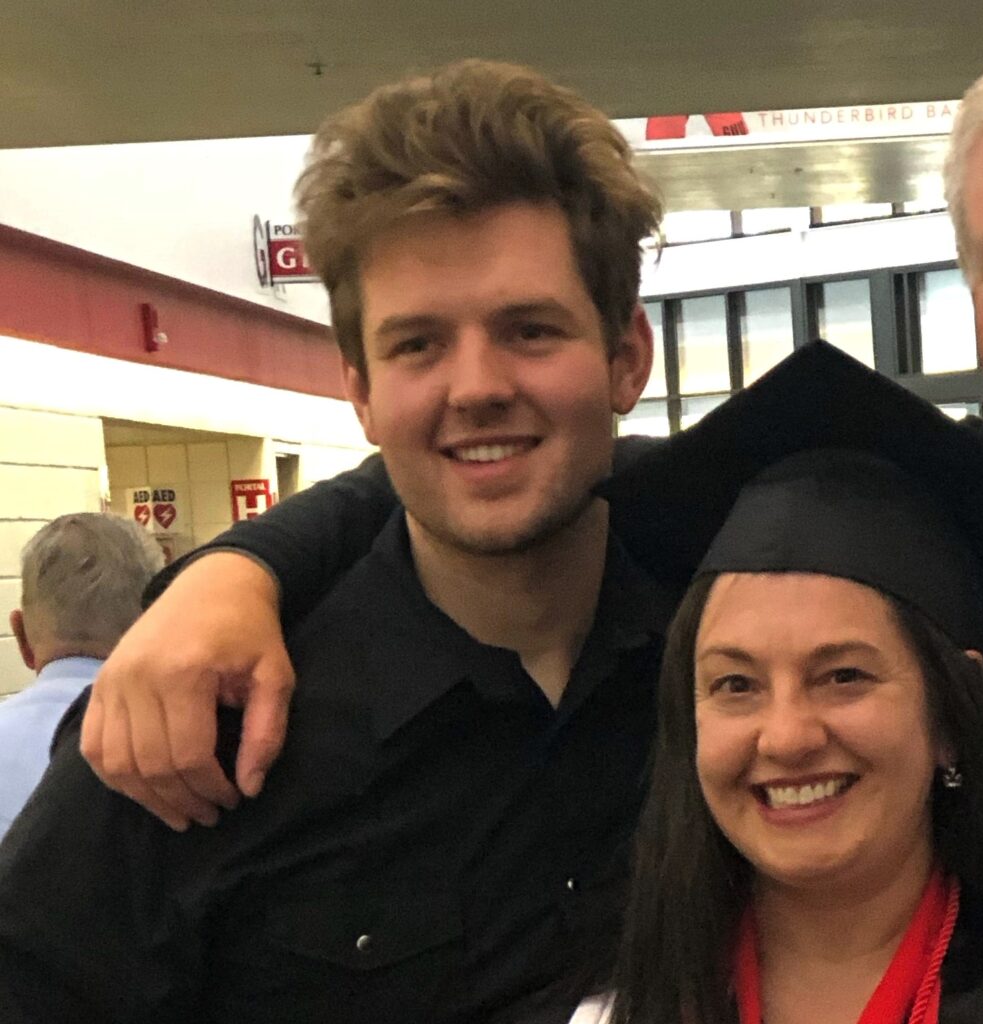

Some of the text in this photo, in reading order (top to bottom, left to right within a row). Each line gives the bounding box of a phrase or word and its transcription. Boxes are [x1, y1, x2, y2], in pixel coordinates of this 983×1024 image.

[758, 105, 913, 129] THUNDERBIRD
[133, 490, 150, 503] AED
[152, 489, 176, 502] AED
[236, 494, 267, 521] H
